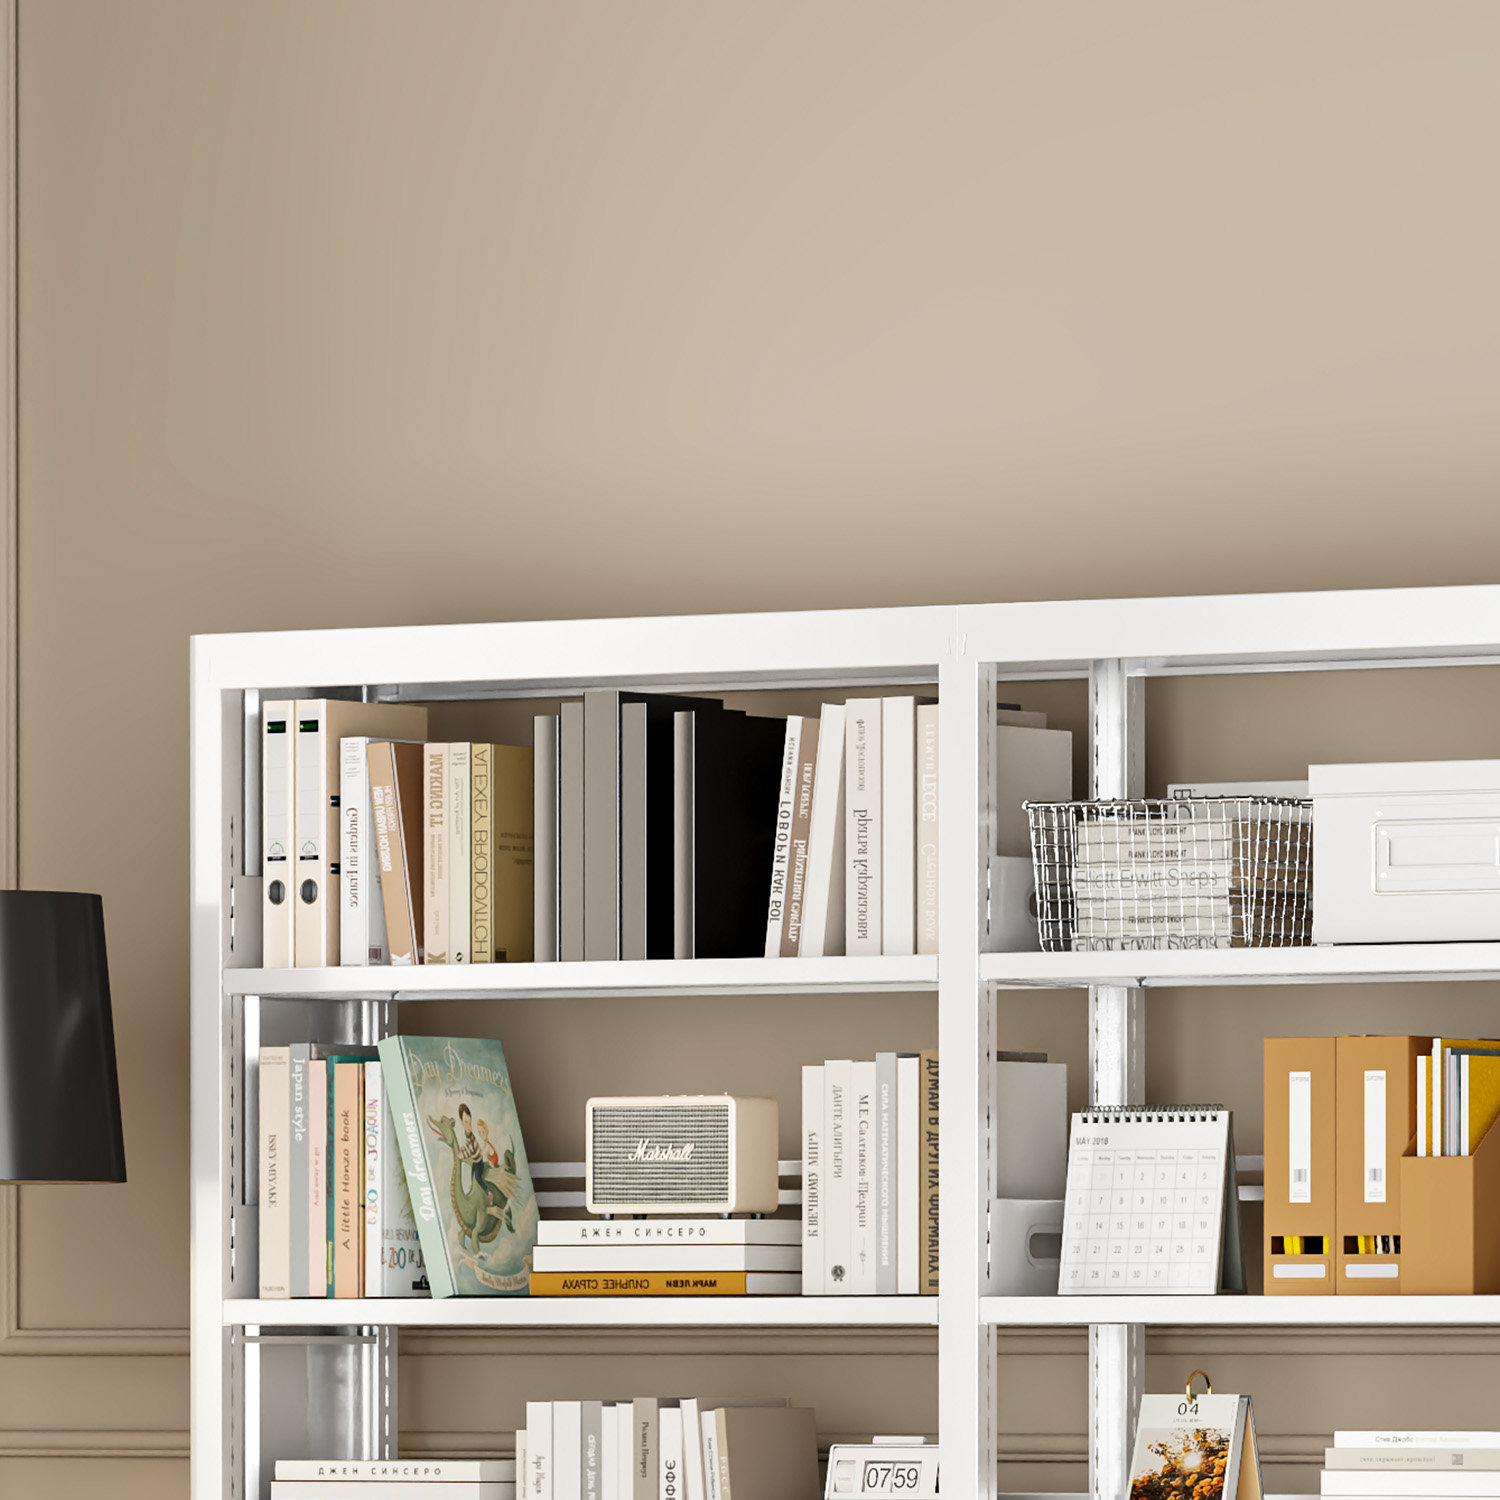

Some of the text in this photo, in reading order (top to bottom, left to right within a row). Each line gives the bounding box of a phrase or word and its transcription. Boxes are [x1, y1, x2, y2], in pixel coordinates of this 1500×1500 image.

[409, 1040, 510, 1094] Day Dreamers
[290, 1058, 306, 1142] Japan style
[267, 1134, 277, 1162] ISSEY
[627, 1138, 695, 1163] Marshall
[1075, 1136, 1109, 1146] MAY 2018
[400, 1111, 437, 1222] Day dreamers
[580, 1227, 706, 1239] ДЖЕН СИНСЕРО
[1177, 1402, 1199, 1415] 04
[318, 1467, 441, 1476] ДЖЕН СИНСЕРО
[866, 1468, 918, 1489] 07 59
